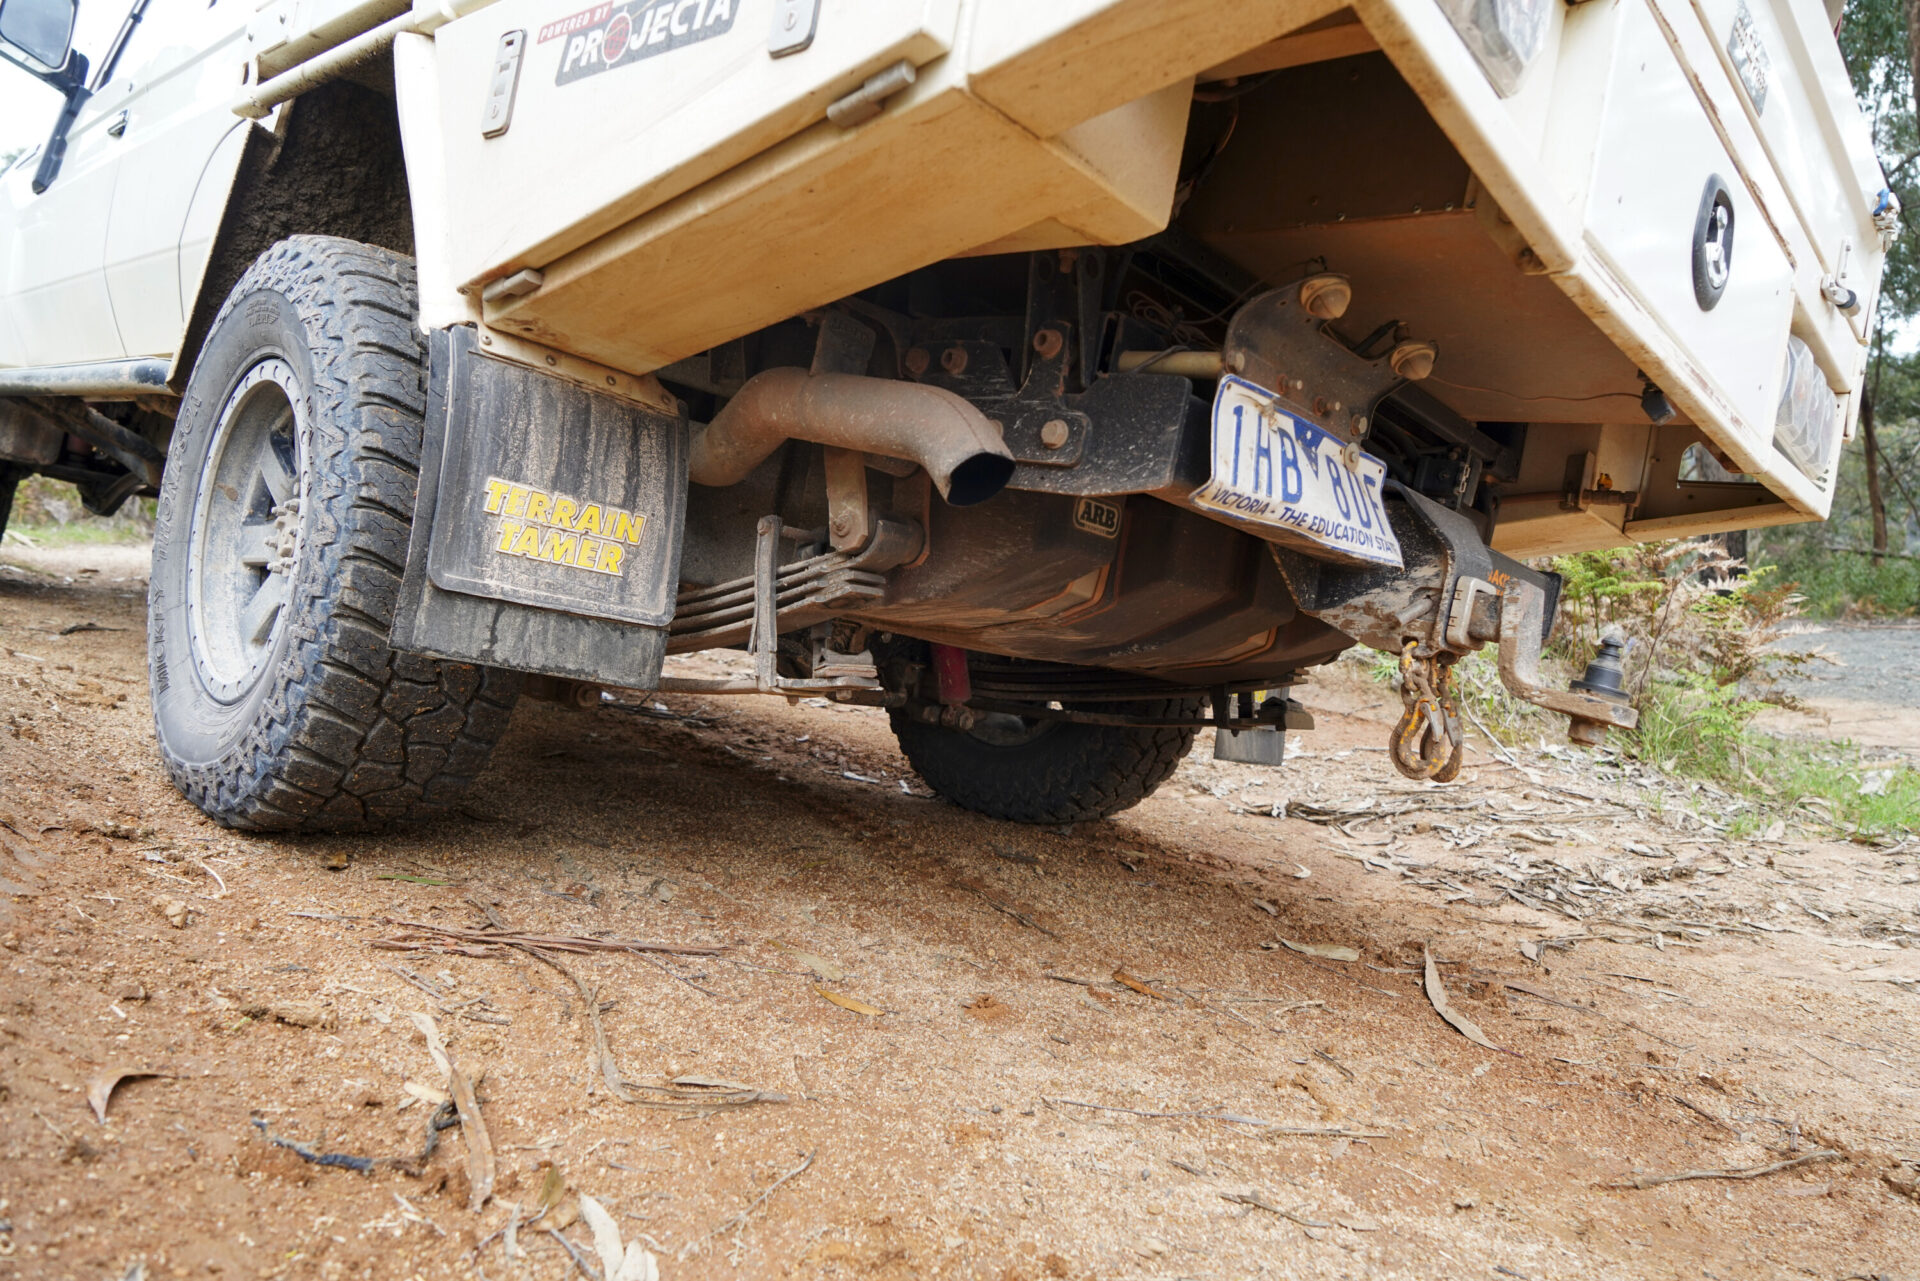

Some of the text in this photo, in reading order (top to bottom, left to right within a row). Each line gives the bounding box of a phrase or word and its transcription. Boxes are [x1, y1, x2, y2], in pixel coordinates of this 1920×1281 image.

[540, 5, 610, 41] POWERED BY
[1230, 405, 1304, 504] 1HB
[484, 477, 647, 545] TERRAIN
[1080, 501, 1116, 530] ARB
[1210, 487, 1270, 517] VICTORIA
[1278, 506, 1309, 528] THE
[1308, 515, 1374, 549] EDUCATION
[497, 519, 623, 576] TAMER
